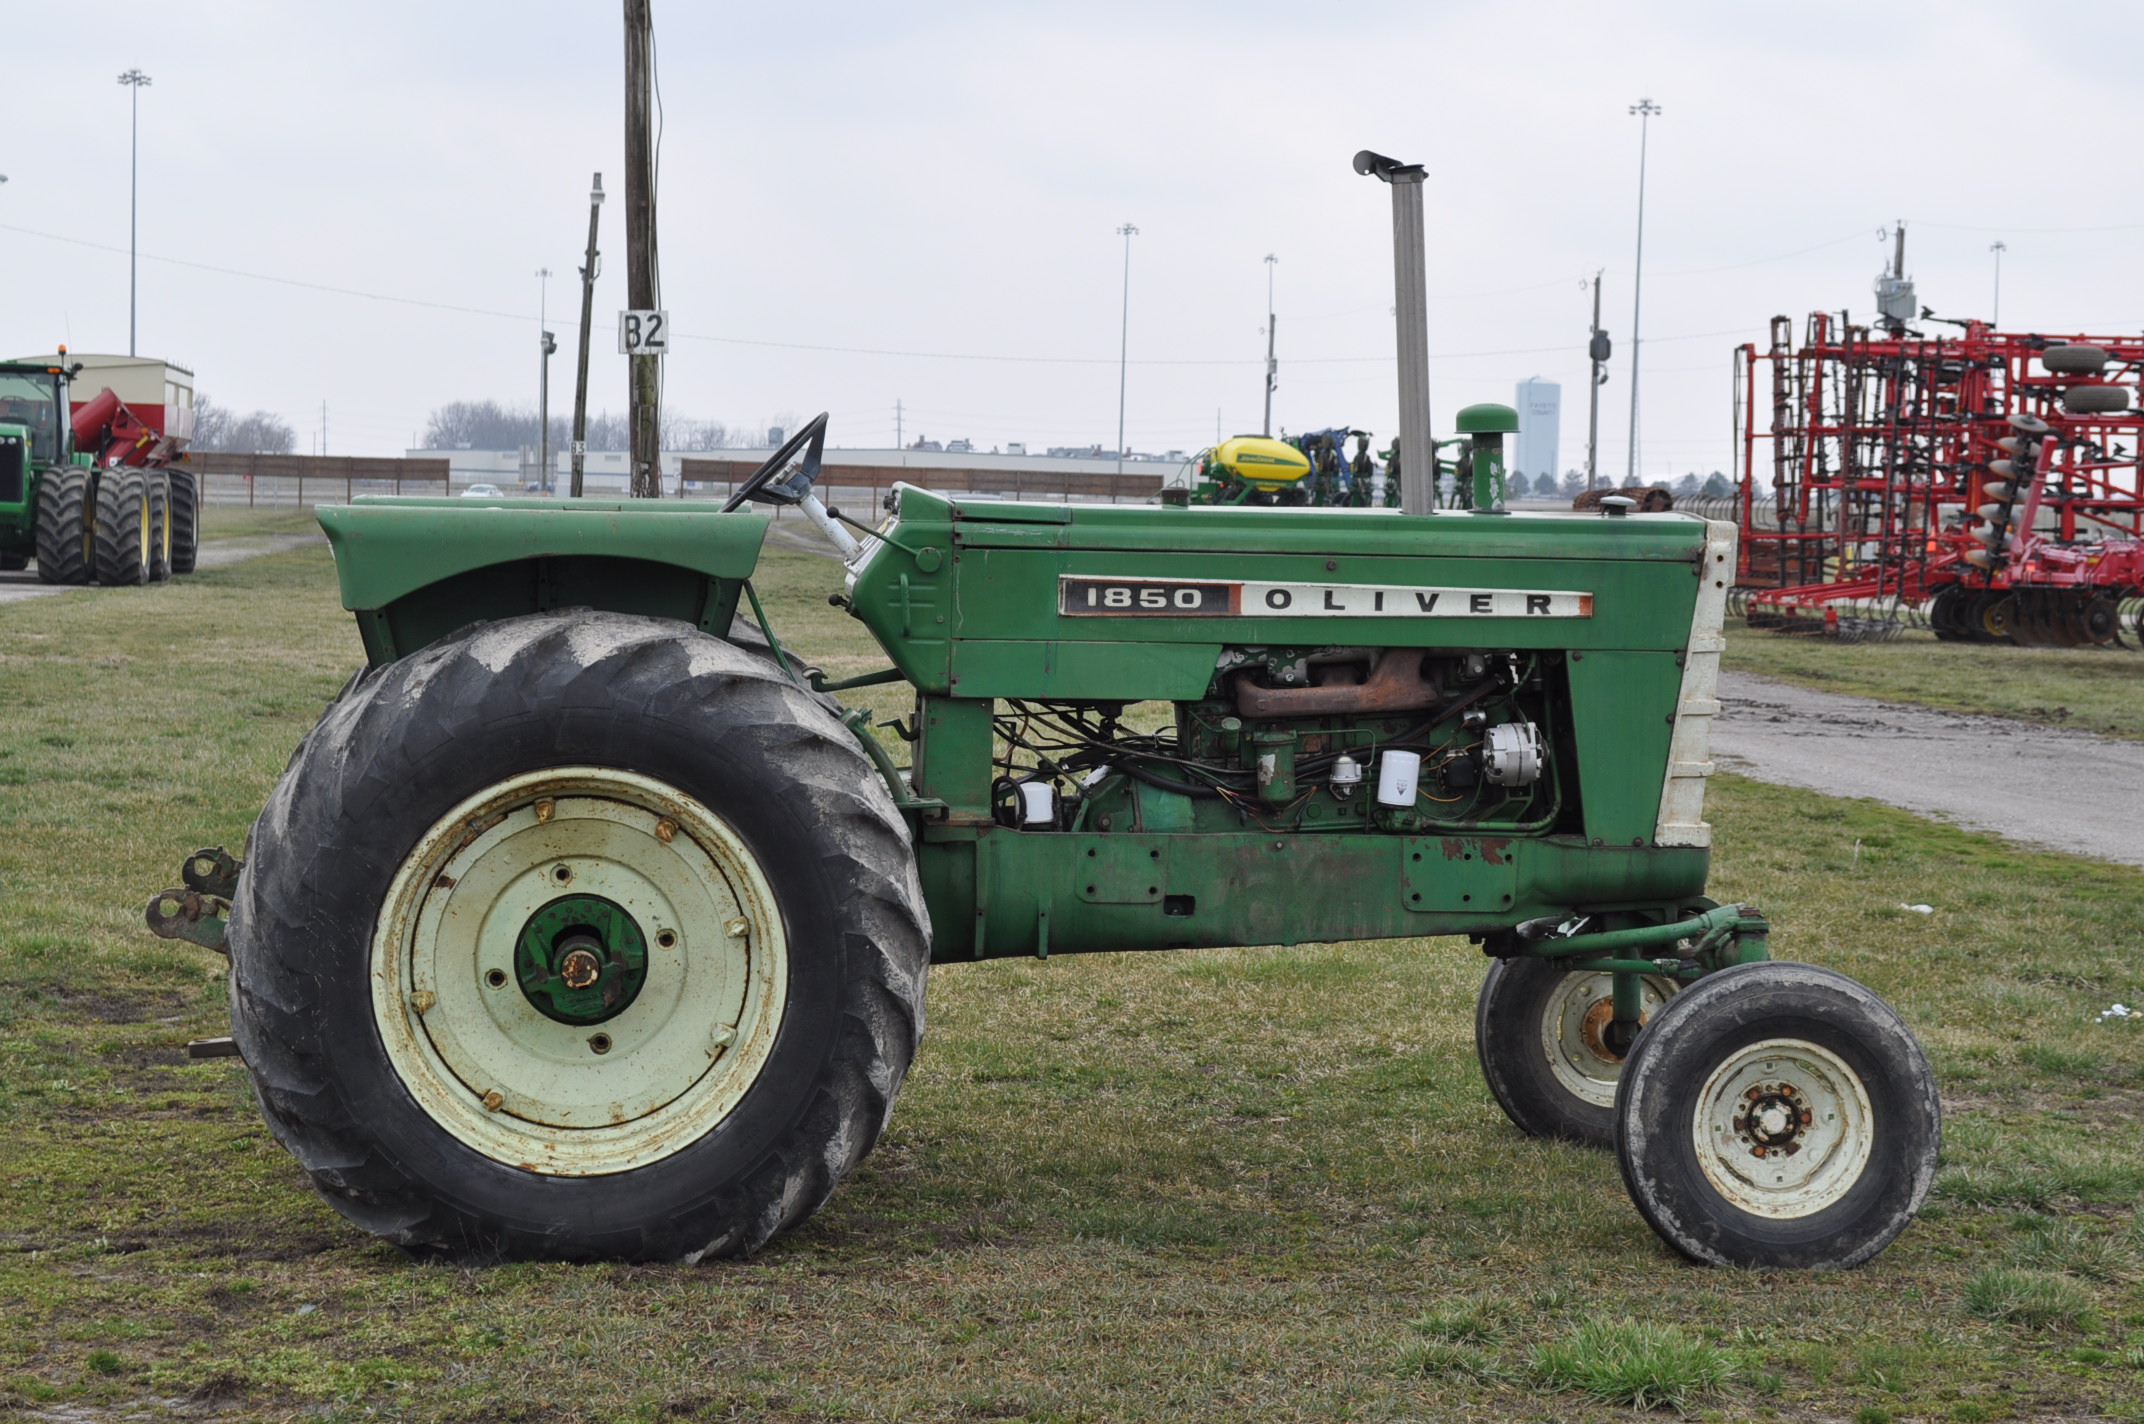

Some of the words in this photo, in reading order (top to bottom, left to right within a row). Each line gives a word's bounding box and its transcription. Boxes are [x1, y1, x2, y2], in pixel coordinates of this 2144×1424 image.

[625, 314, 664, 349] B2
[571, 442, 585, 454] B3
[1087, 587, 1202, 608] 1850
[1265, 588, 1551, 615] OLIVER
